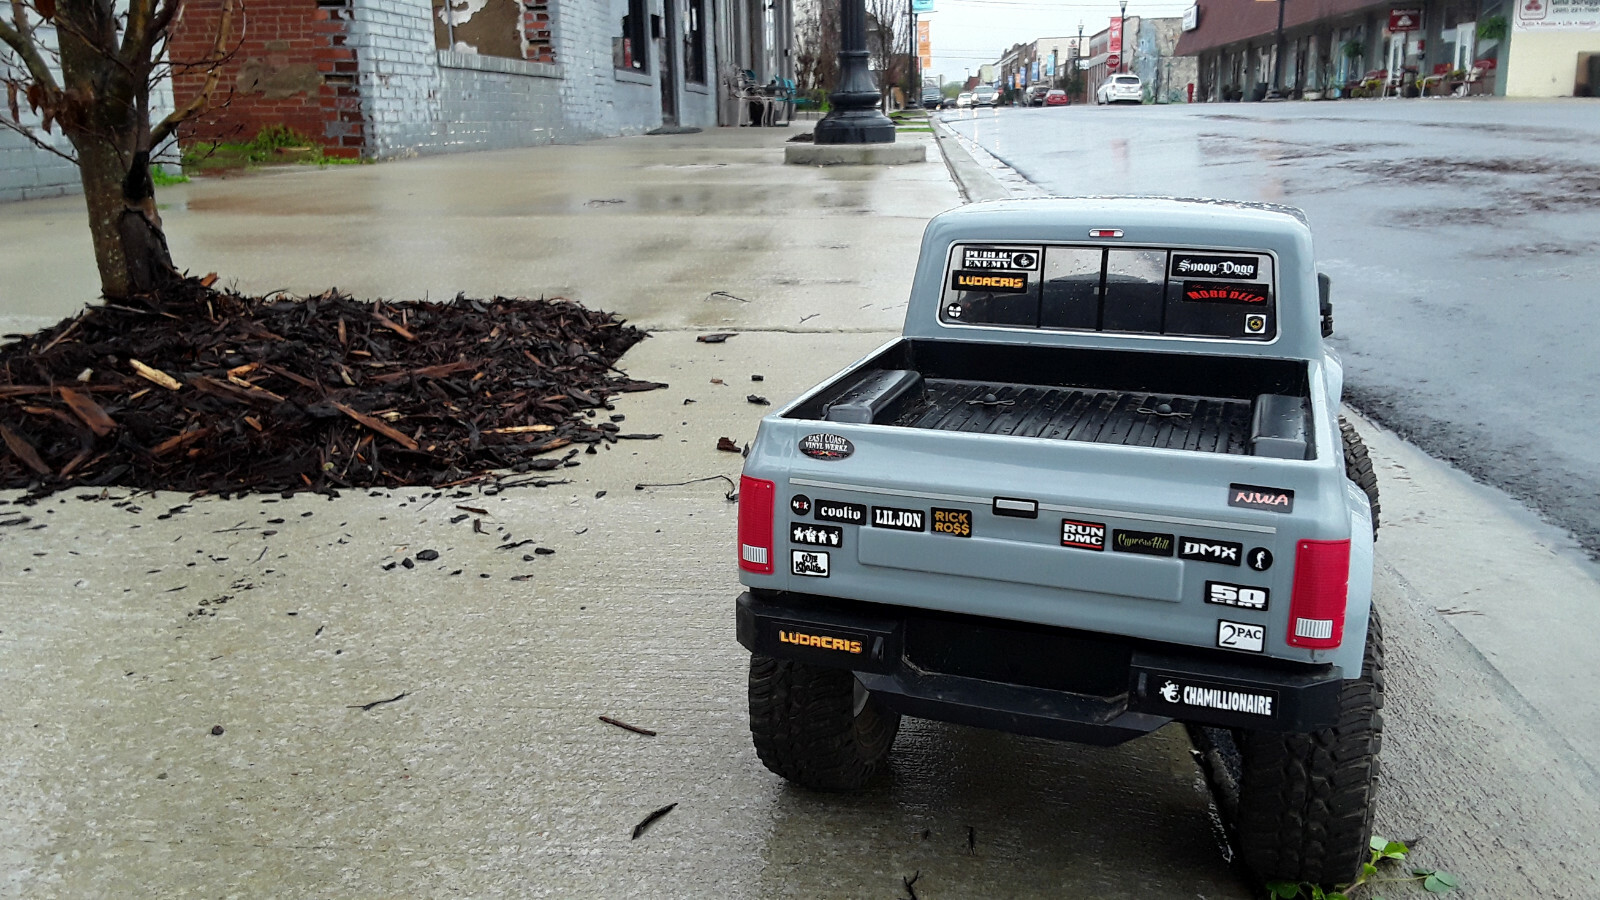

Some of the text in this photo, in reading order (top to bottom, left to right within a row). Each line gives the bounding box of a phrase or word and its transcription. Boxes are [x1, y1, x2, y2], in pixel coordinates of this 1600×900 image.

[966, 250, 1011, 258] PUBLIC
[965, 260, 1010, 268] ENEMY
[1177, 259, 1254, 276] Snoop Dogg
[959, 275, 1024, 288] LUDACRIS
[1187, 290, 1264, 302] MOBB DEEP
[805, 441, 848, 452] VINYL WERKZ
[808, 434, 846, 445] EAST COAST
[821, 506, 861, 520] coolio
[935, 510, 968, 524] RICK
[934, 522, 970, 536] RO$$
[1063, 523, 1104, 537] RUN
[1063, 532, 1102, 545] DMC
[1118, 533, 1170, 550] Cypress Hill
[1182, 541, 1237, 561] DMX
[1210, 584, 1266, 603] 50
[1211, 597, 1266, 608] CENT
[779, 630, 862, 653] LUDACRIS
[1222, 624, 1262, 645] 2PAC
[1183, 685, 1272, 716] CHAMILLIONAIRE
